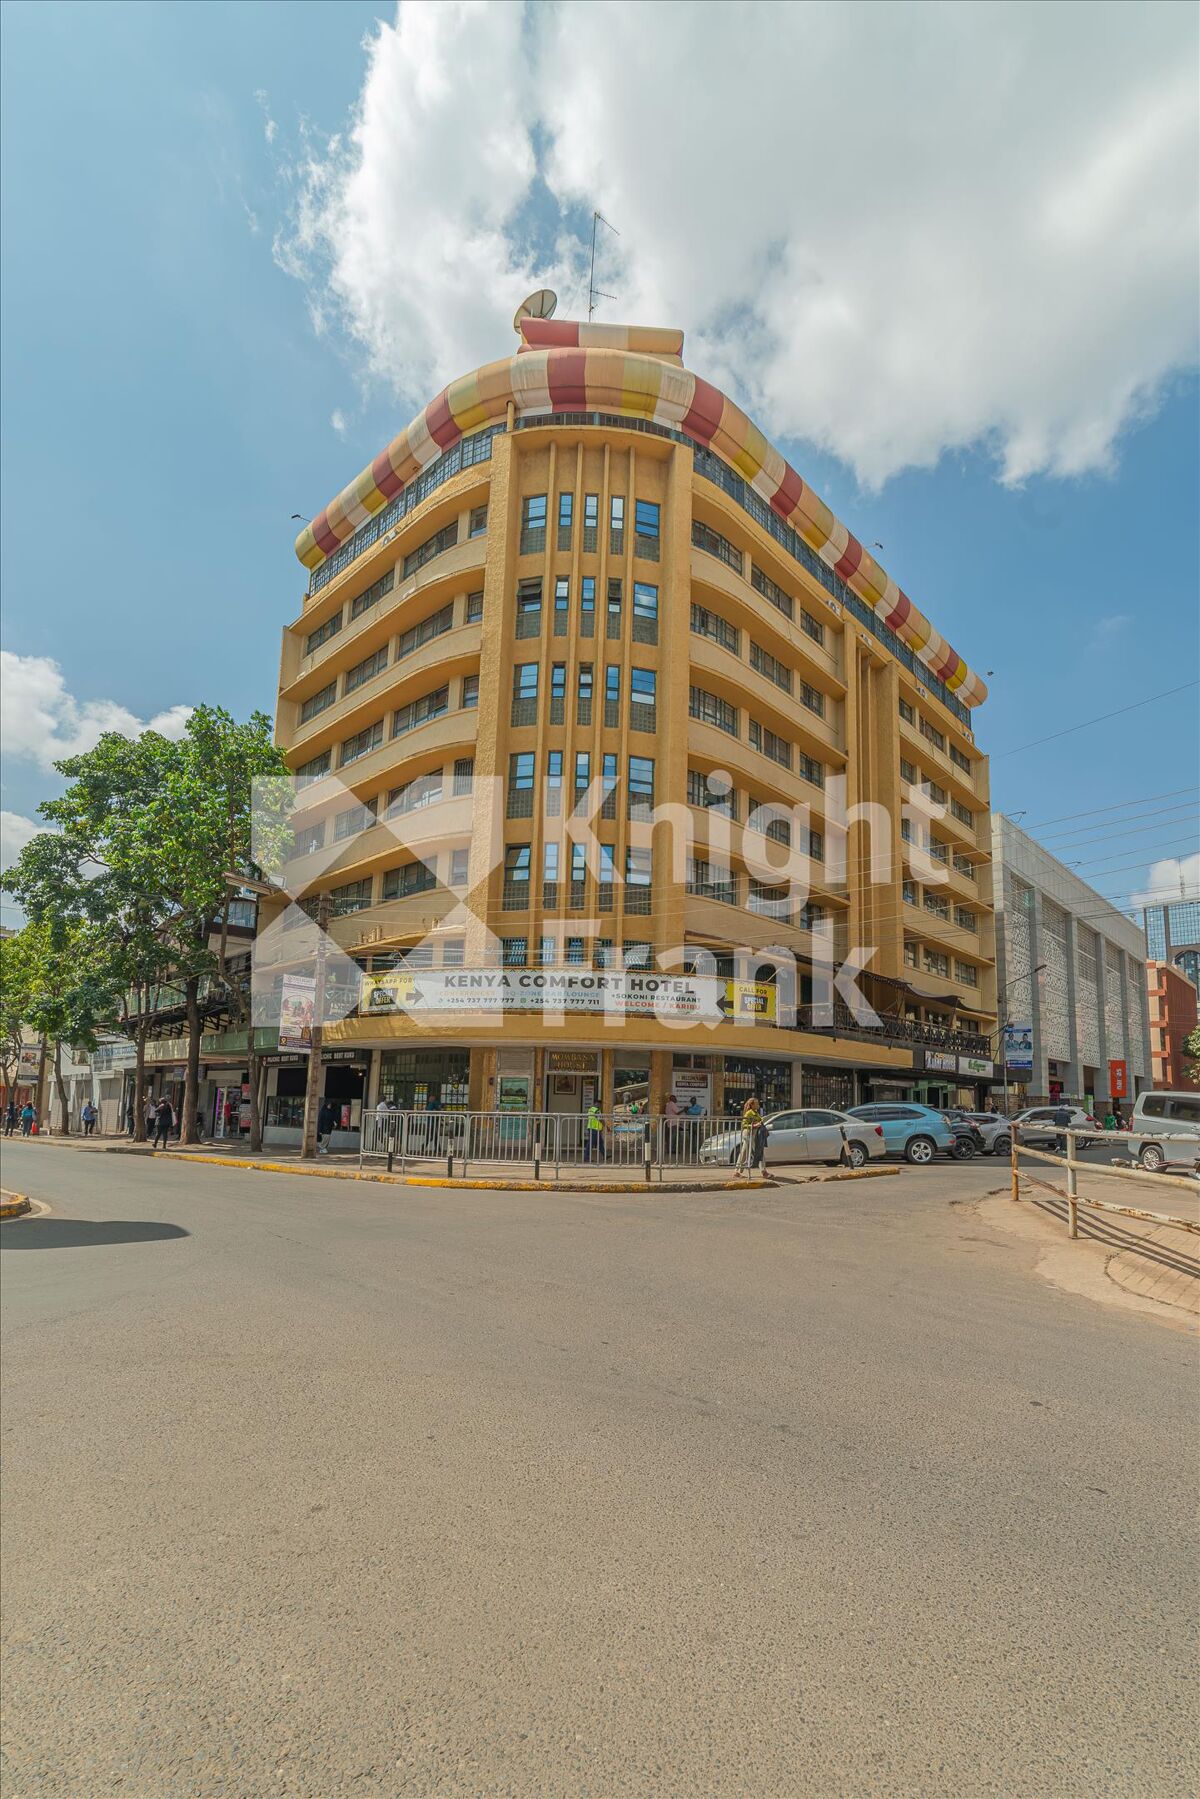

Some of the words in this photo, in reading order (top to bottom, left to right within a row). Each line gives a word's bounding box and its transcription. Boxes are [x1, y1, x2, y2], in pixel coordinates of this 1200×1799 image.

[444, 975, 512, 989] KENYA
[519, 975, 623, 990] COMFORT
[630, 978, 696, 995] HOTEL
[738, 986, 755, 994] CALL
[650, 995, 702, 1003] RESTAURANT
[614, 1000, 660, 1009] WELCOME
[551, 1052, 596, 1061] MOMBASA
[556, 1061, 588, 1070] HOUSE
